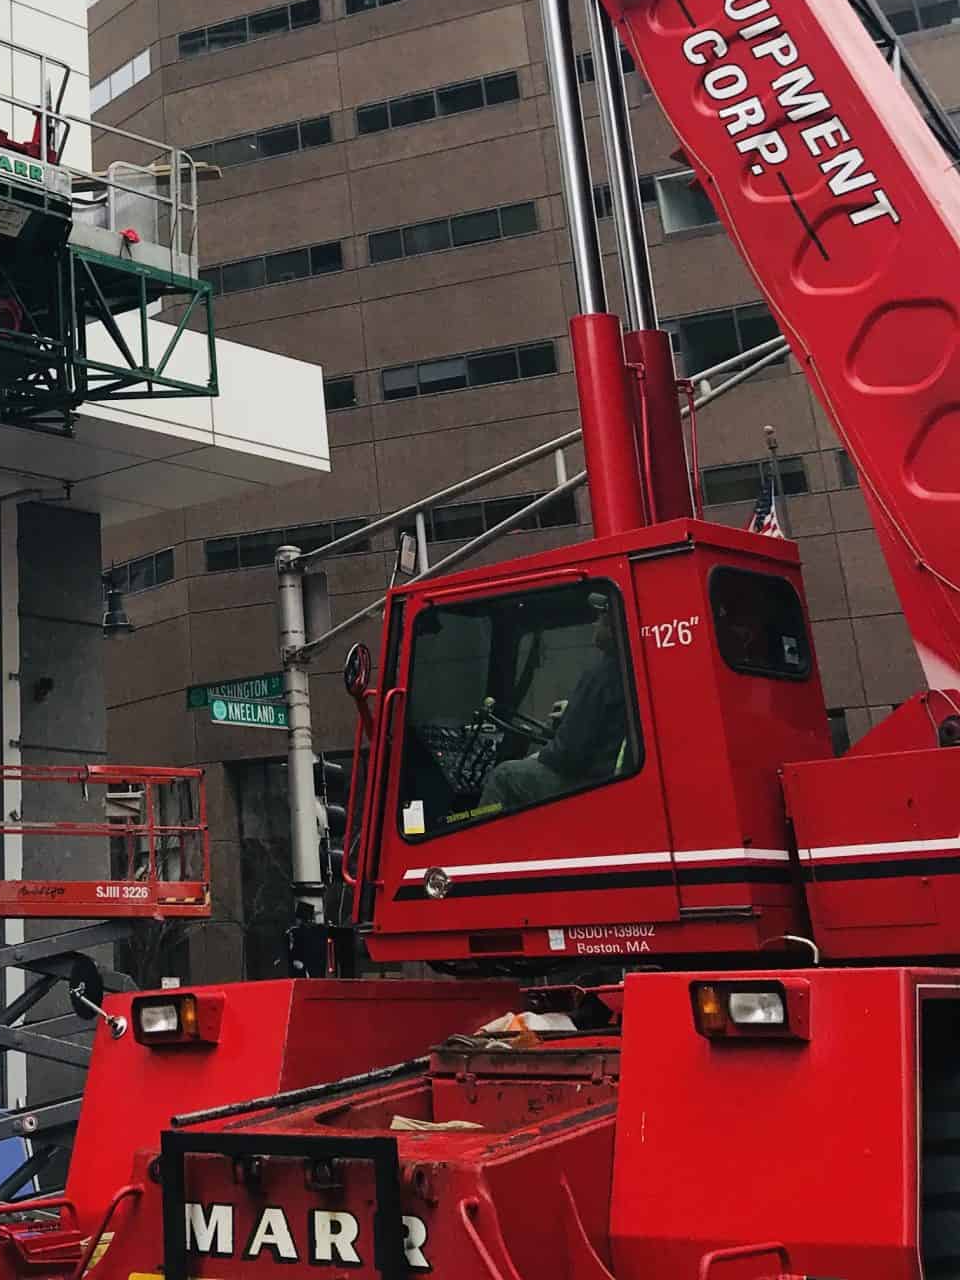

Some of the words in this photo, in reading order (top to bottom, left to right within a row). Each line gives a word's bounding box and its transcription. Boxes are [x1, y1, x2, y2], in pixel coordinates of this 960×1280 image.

[682, 29, 789, 176] CORP.
[208, 679, 268, 698] WASHINGTON
[227, 701, 275, 723] KNEELAND
[122, 886, 149, 898] 3226
[626, 941, 650, 953] MA
[185, 1203, 430, 1268] MARR
